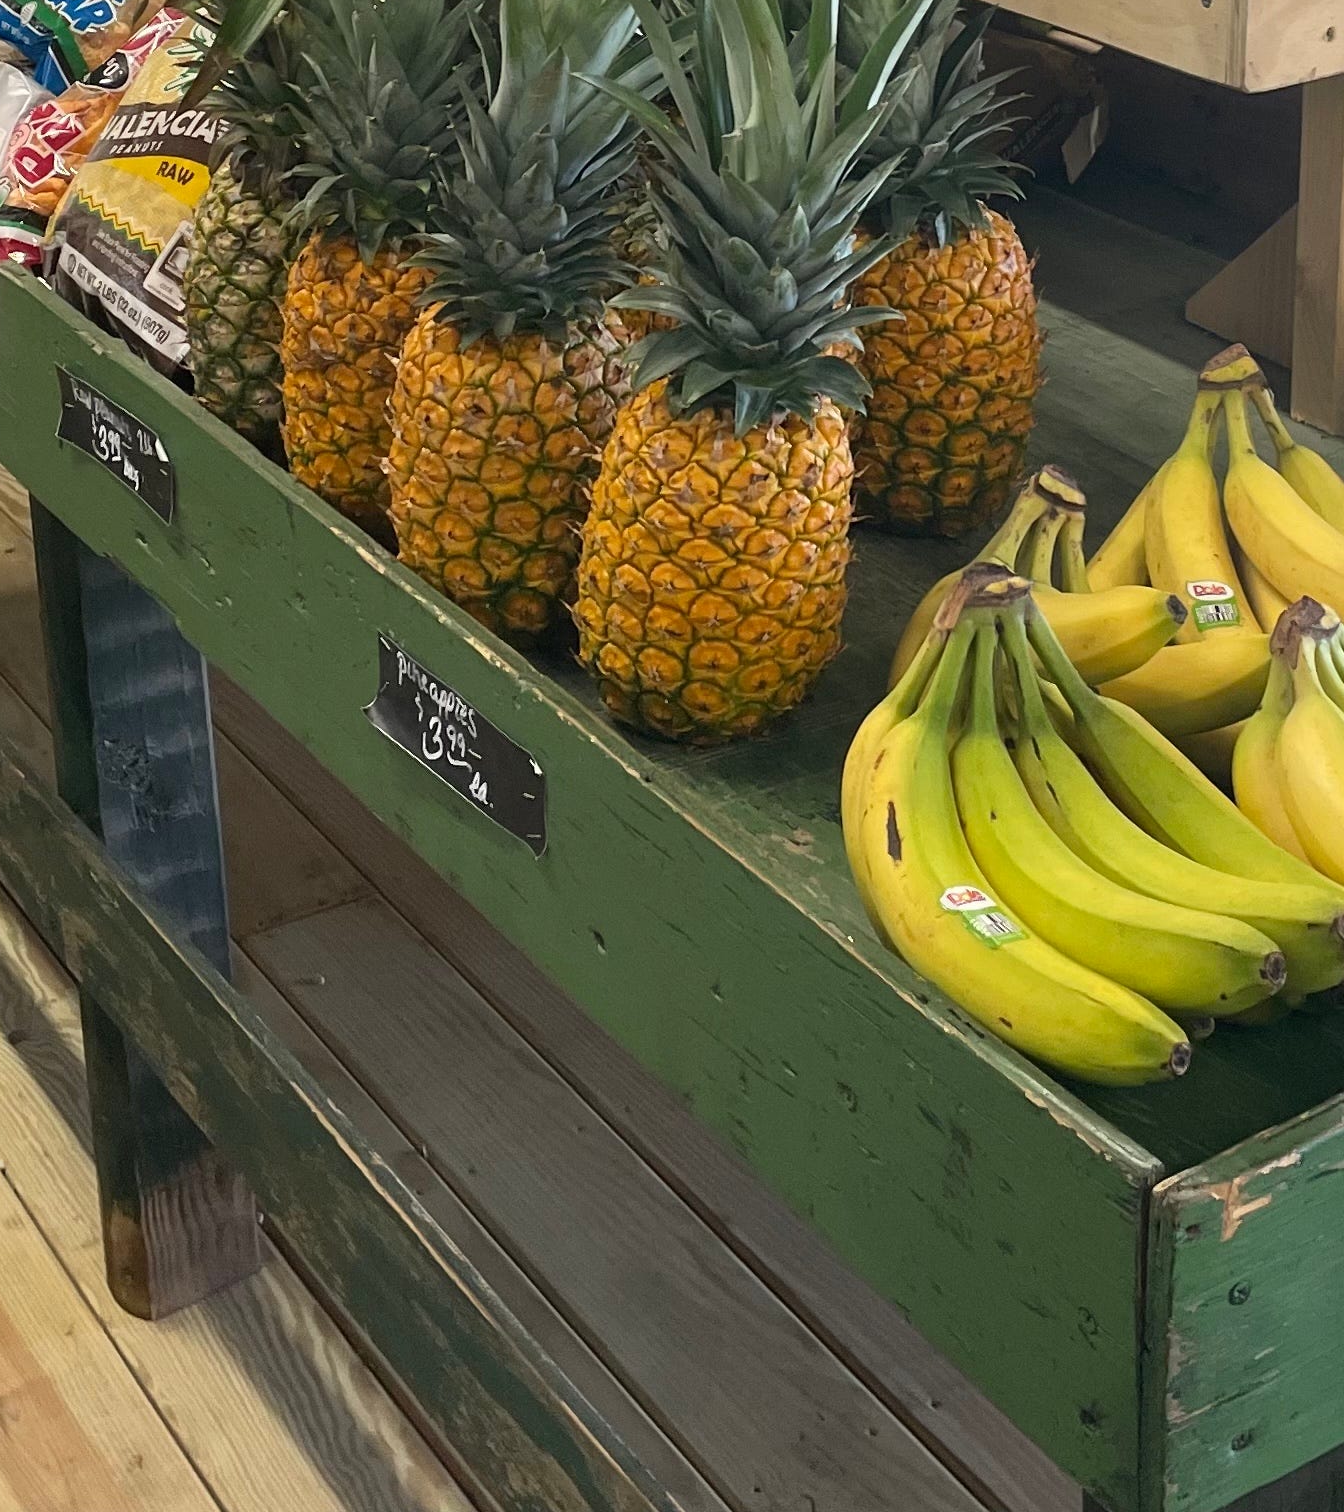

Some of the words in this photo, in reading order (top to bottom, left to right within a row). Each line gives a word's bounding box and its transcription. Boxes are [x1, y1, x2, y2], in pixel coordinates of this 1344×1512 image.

[109, 140, 164, 155] PEANUTS
[157, 161, 194, 186] RAW
[1193, 584, 1228, 597] Dole
[947, 889, 986, 906] Dole
